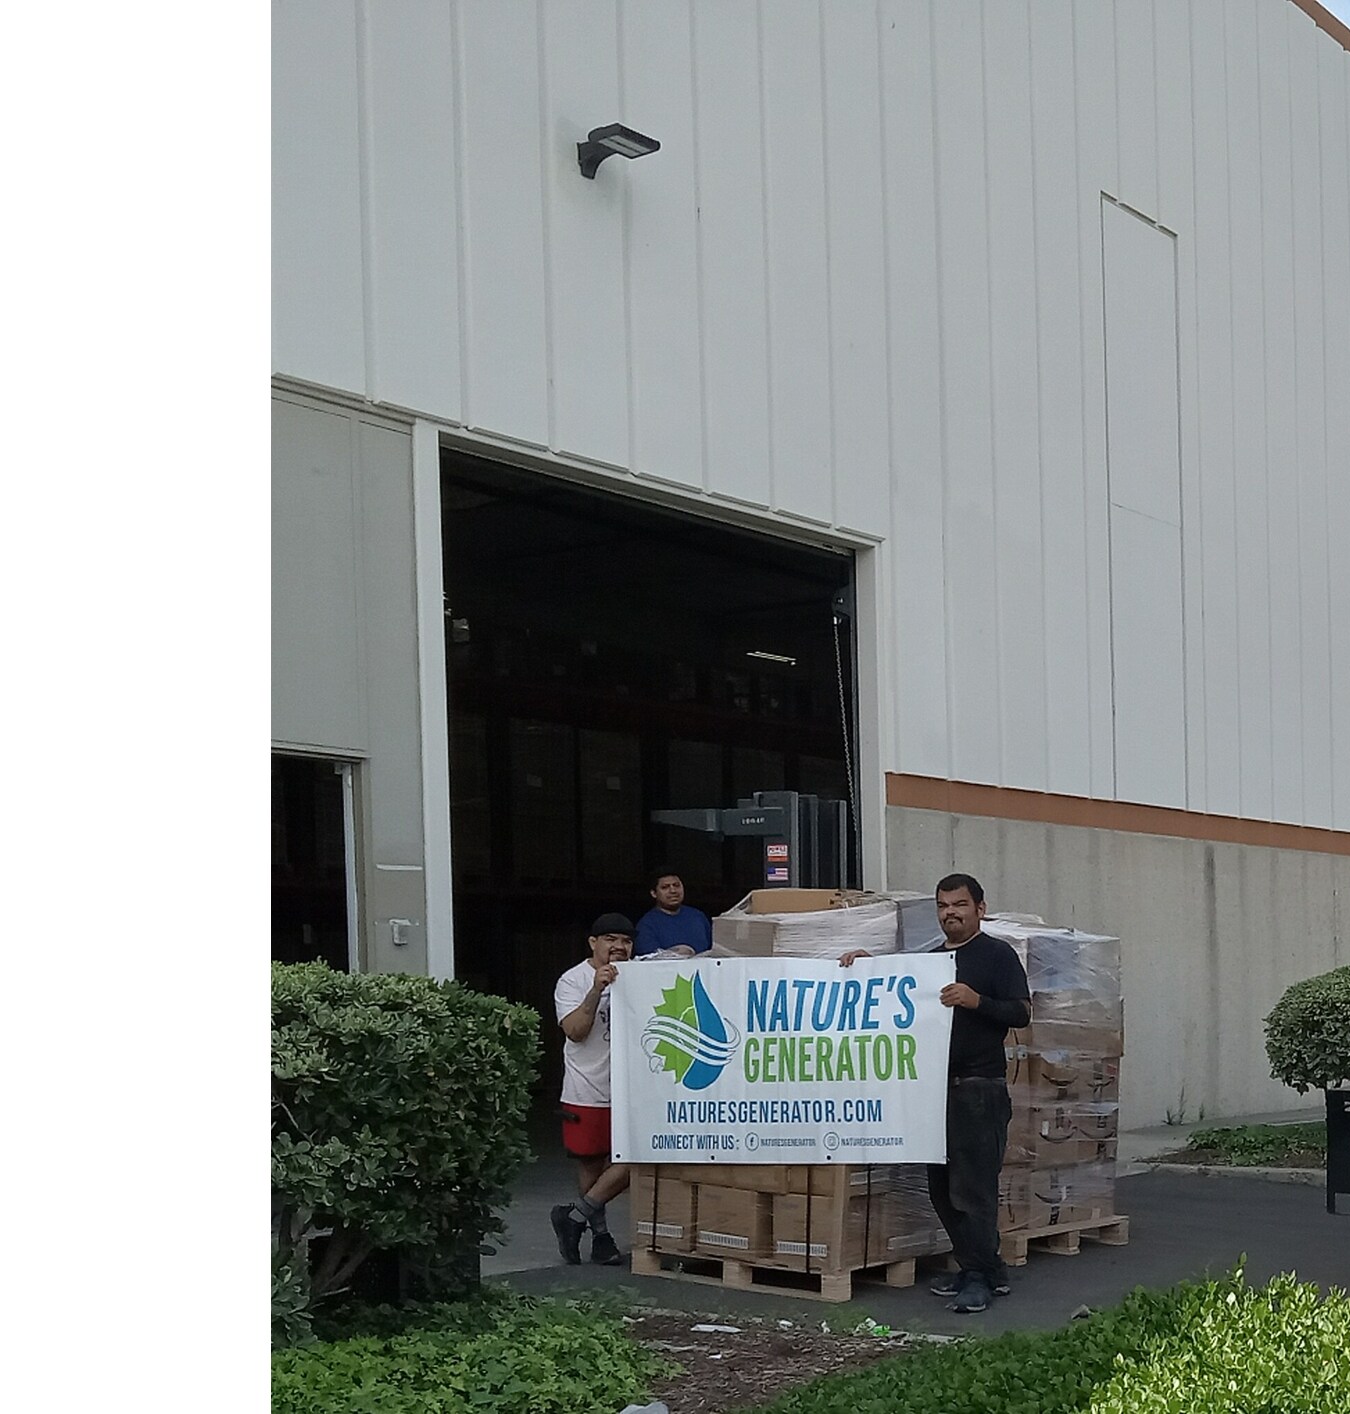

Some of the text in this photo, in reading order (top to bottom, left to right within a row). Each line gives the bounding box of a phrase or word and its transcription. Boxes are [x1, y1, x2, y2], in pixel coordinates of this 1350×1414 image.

[747, 975, 917, 1033] NATURE'S
[743, 1034, 919, 1083] GENERATOR
[667, 1099, 882, 1124] NATURESGENERATOR.COM
[651, 1134, 694, 1150] CONNECT
[696, 1134, 719, 1150] WITH
[760, 1138, 817, 1147] NATURESGENERATOR
[841, 1136, 904, 1147] NATURESGENERATOR
